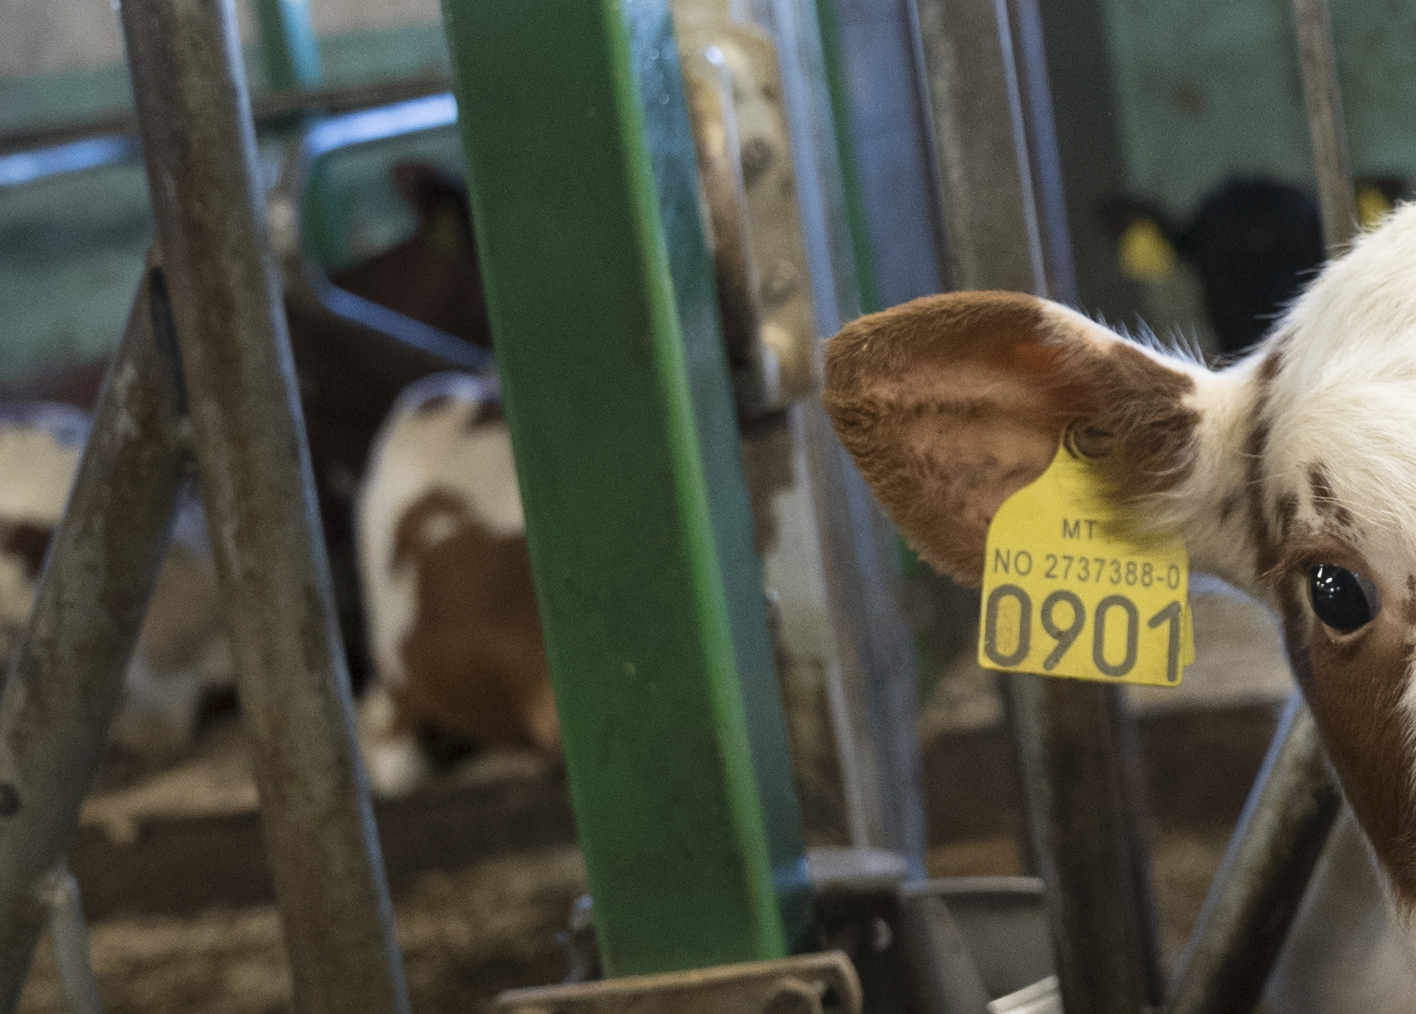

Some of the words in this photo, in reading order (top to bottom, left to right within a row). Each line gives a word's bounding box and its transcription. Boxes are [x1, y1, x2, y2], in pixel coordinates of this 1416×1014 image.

[1062, 518, 1097, 541] MT
[993, 547, 1034, 577] NO
[1044, 553, 1181, 590] 2737388-0
[984, 583, 1182, 683] 0901
